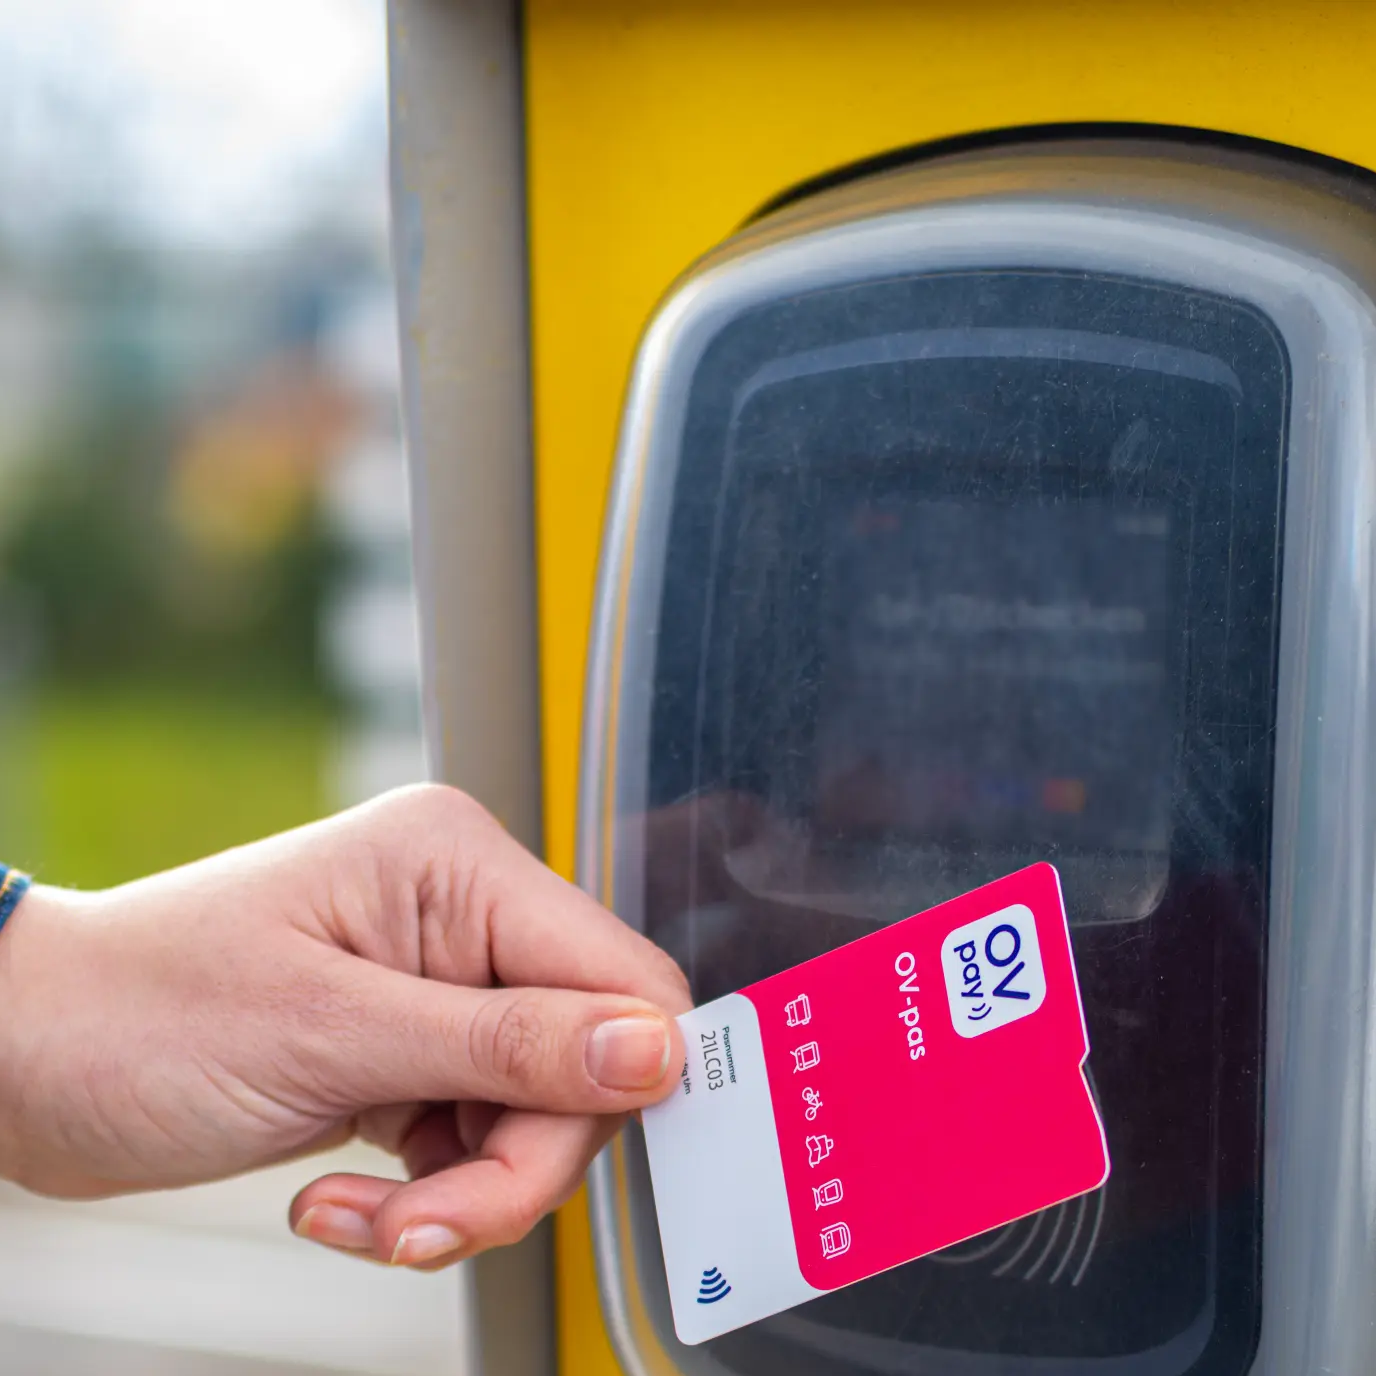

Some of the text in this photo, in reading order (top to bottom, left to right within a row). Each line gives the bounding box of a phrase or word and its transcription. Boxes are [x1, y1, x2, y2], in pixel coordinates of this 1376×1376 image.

[953, 940, 984, 998] pay
[984, 924, 1031, 1001] OV
[894, 951, 926, 1061] OV-pas
[701, 1030, 724, 1091] 21LC03
[722, 1026, 737, 1084] Pasnummer
